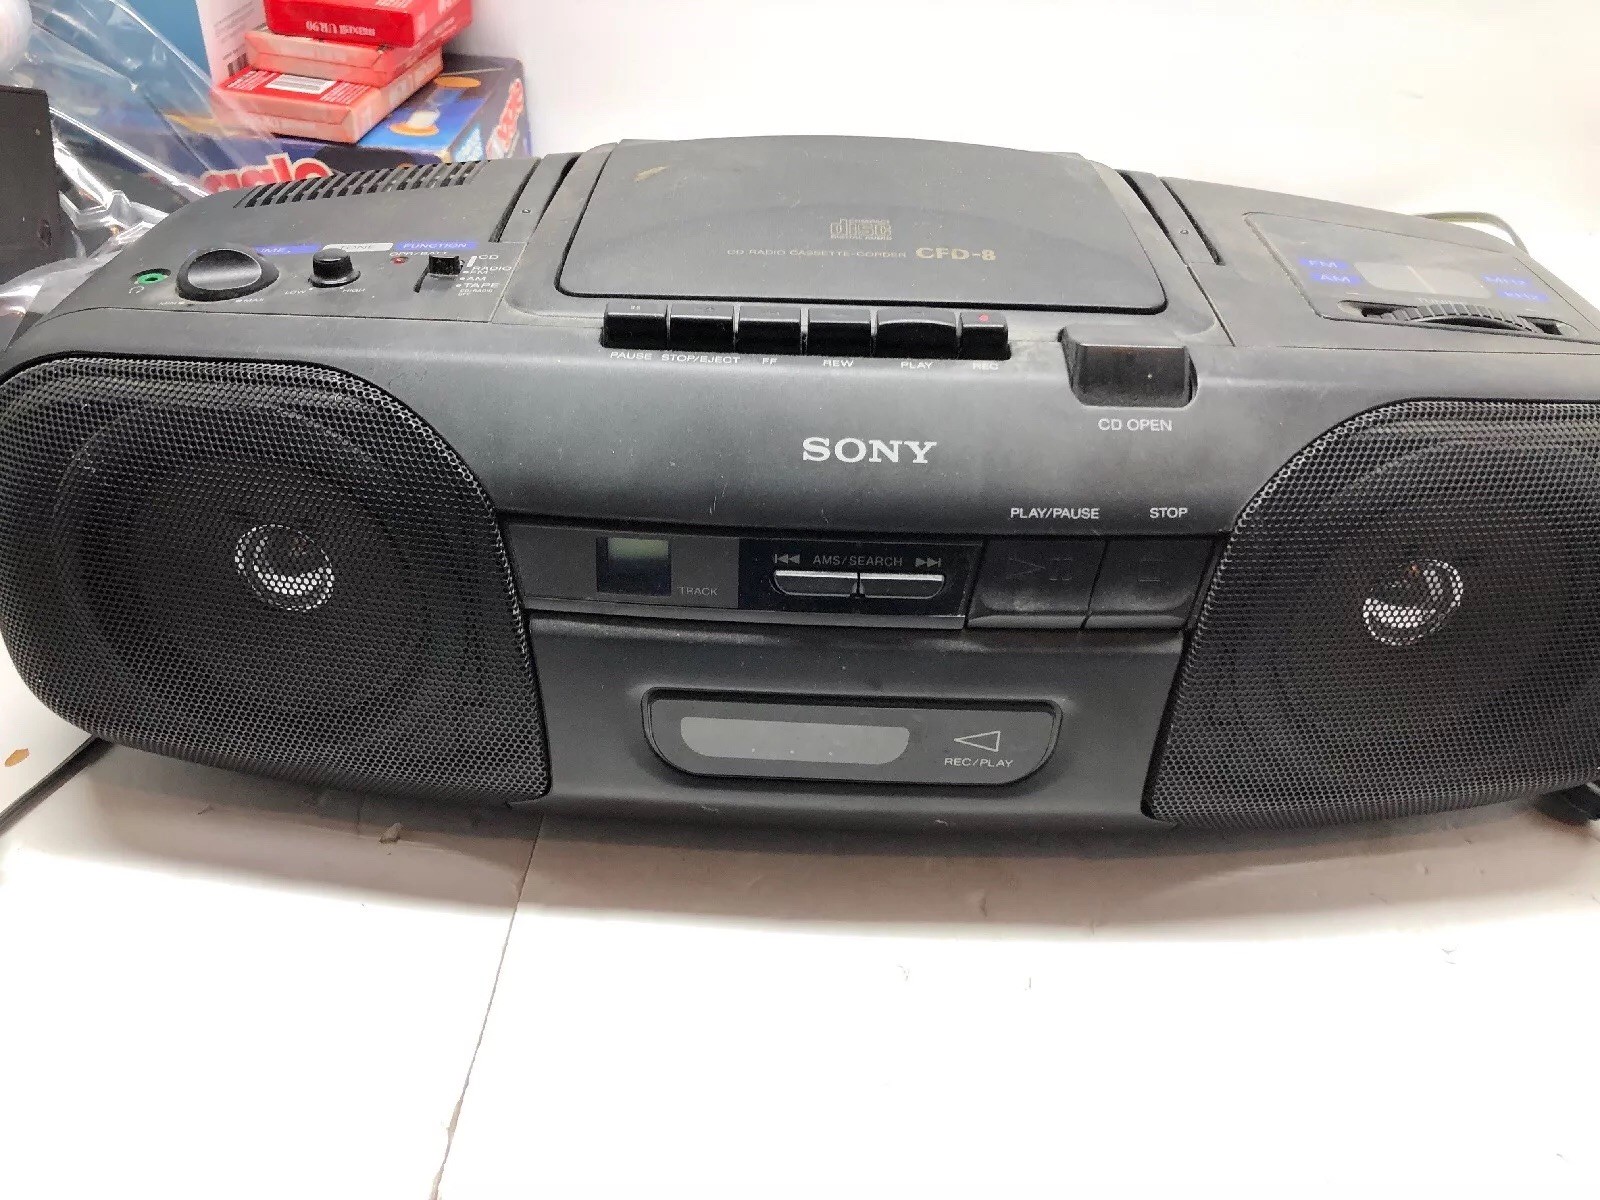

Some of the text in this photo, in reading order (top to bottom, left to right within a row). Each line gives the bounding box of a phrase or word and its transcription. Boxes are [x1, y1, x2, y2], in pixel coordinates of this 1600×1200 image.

[915, 246, 997, 262] CFD-8
[610, 350, 652, 361] PAUSE
[661, 353, 741, 365] STOP/EJECT
[761, 357, 778, 366] FF
[823, 358, 854, 368] REW
[900, 360, 934, 370] PLAY
[972, 361, 999, 371] REC
[1098, 418, 1173, 432] CD OPEN
[802, 436, 938, 464] SONY
[1010, 507, 1100, 520] PLAY/PAUSE
[1149, 507, 1188, 519] STOP
[812, 554, 903, 567] AMS/SEARCH
[679, 586, 719, 597] TRACK
[944, 757, 1014, 769] REC/PLAY
